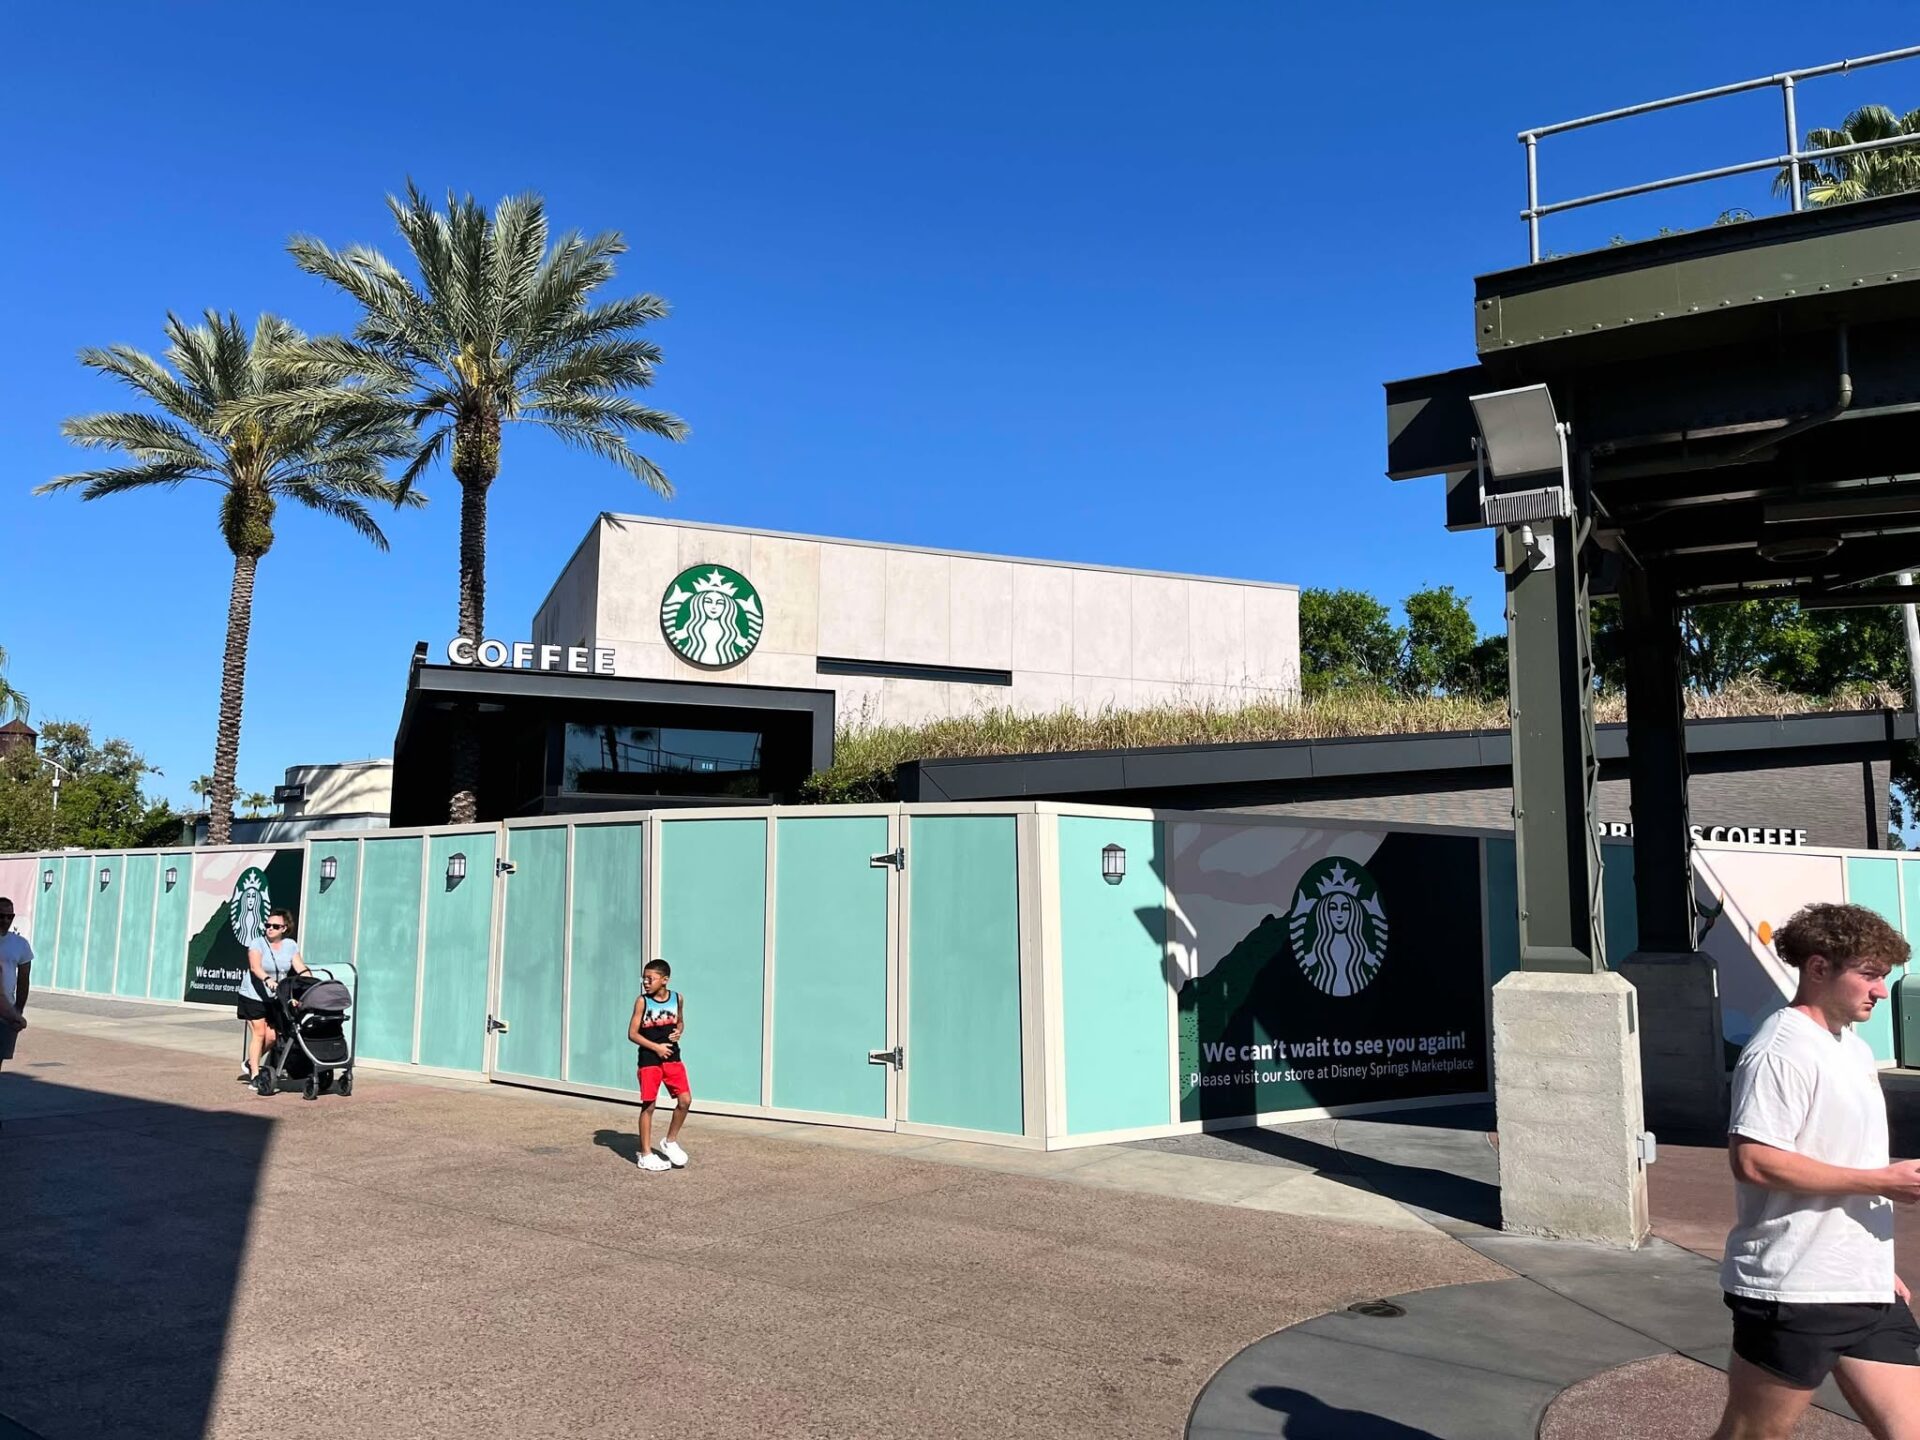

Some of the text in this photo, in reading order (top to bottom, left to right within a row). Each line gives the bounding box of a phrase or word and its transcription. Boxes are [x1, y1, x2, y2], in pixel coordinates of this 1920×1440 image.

[448, 637, 615, 675] COFFEE
[190, 980, 204, 990] Please
[195, 966, 207, 978] We
[208, 967, 226, 979] can’t
[226, 968, 242, 980] wait
[1203, 1030, 1466, 1063] We can’t wait to see you again!
[1190, 1057, 1474, 1088] Please visit our store at Disney Springs Marketplace
